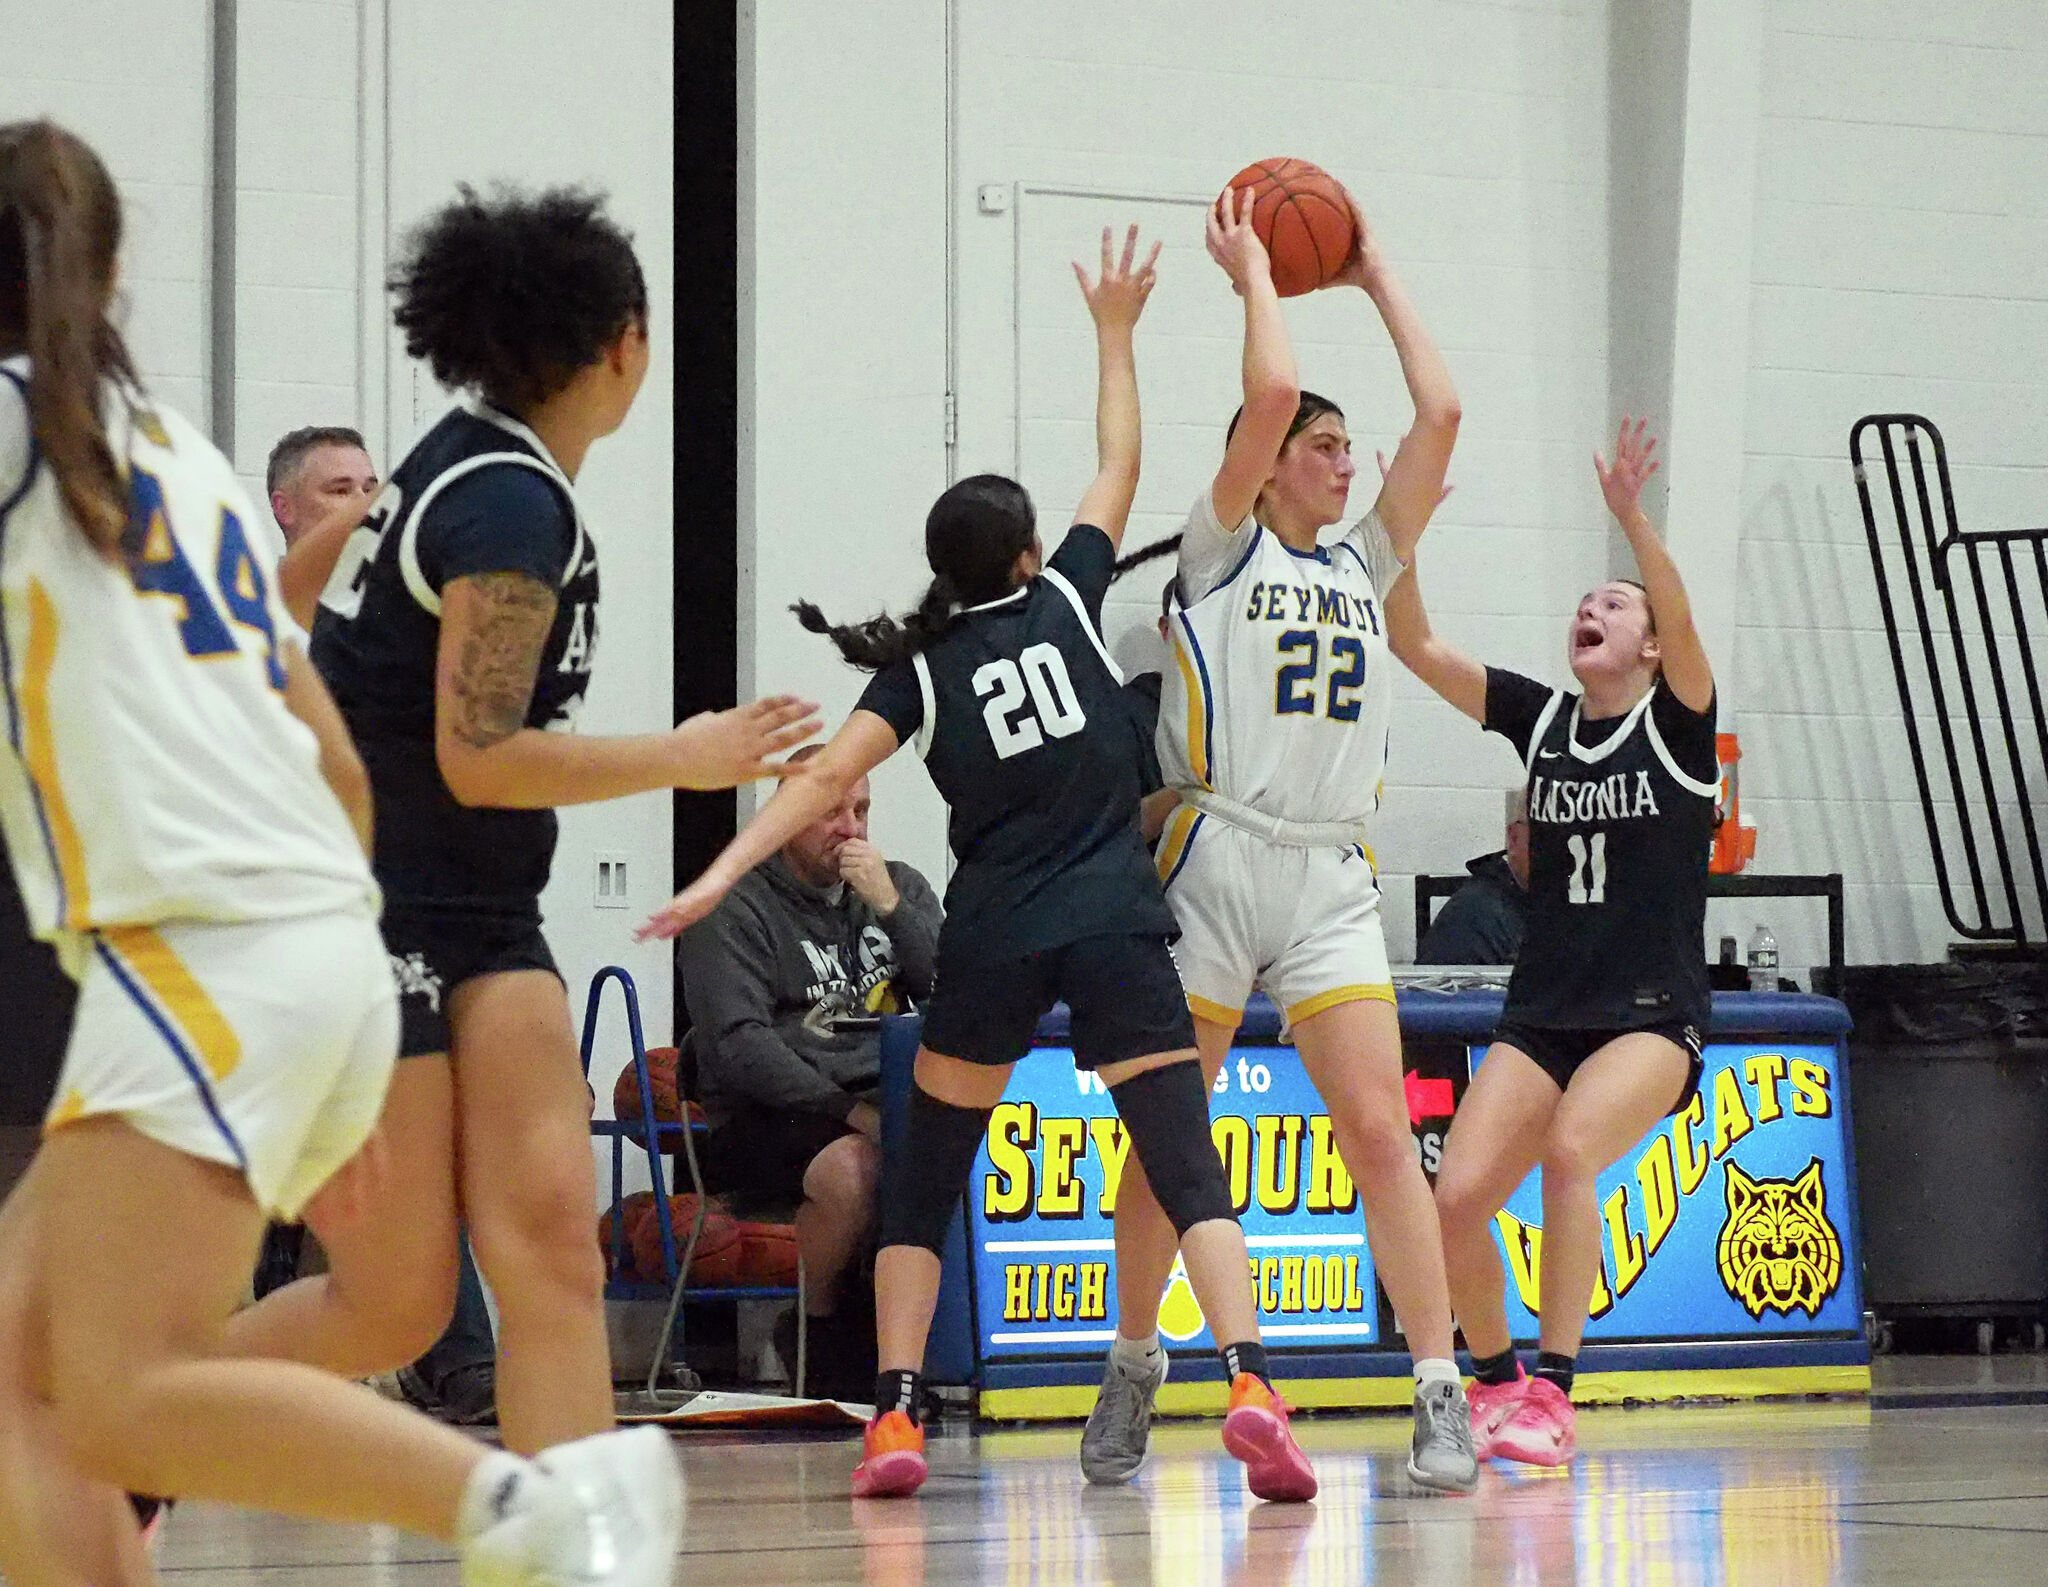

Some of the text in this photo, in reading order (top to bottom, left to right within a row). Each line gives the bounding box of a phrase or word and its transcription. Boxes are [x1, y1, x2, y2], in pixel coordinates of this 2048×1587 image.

[124, 461, 288, 692] 44
[971, 642, 1087, 760] 20
[1275, 628, 1366, 723] 22
[1529, 770, 1660, 824] ANSONIA
[1567, 832, 1606, 904] 11
[1237, 1056, 1271, 1093] to
[984, 1101, 1358, 1223] SEYOUR
[1003, 1262, 1109, 1323] HIGH
